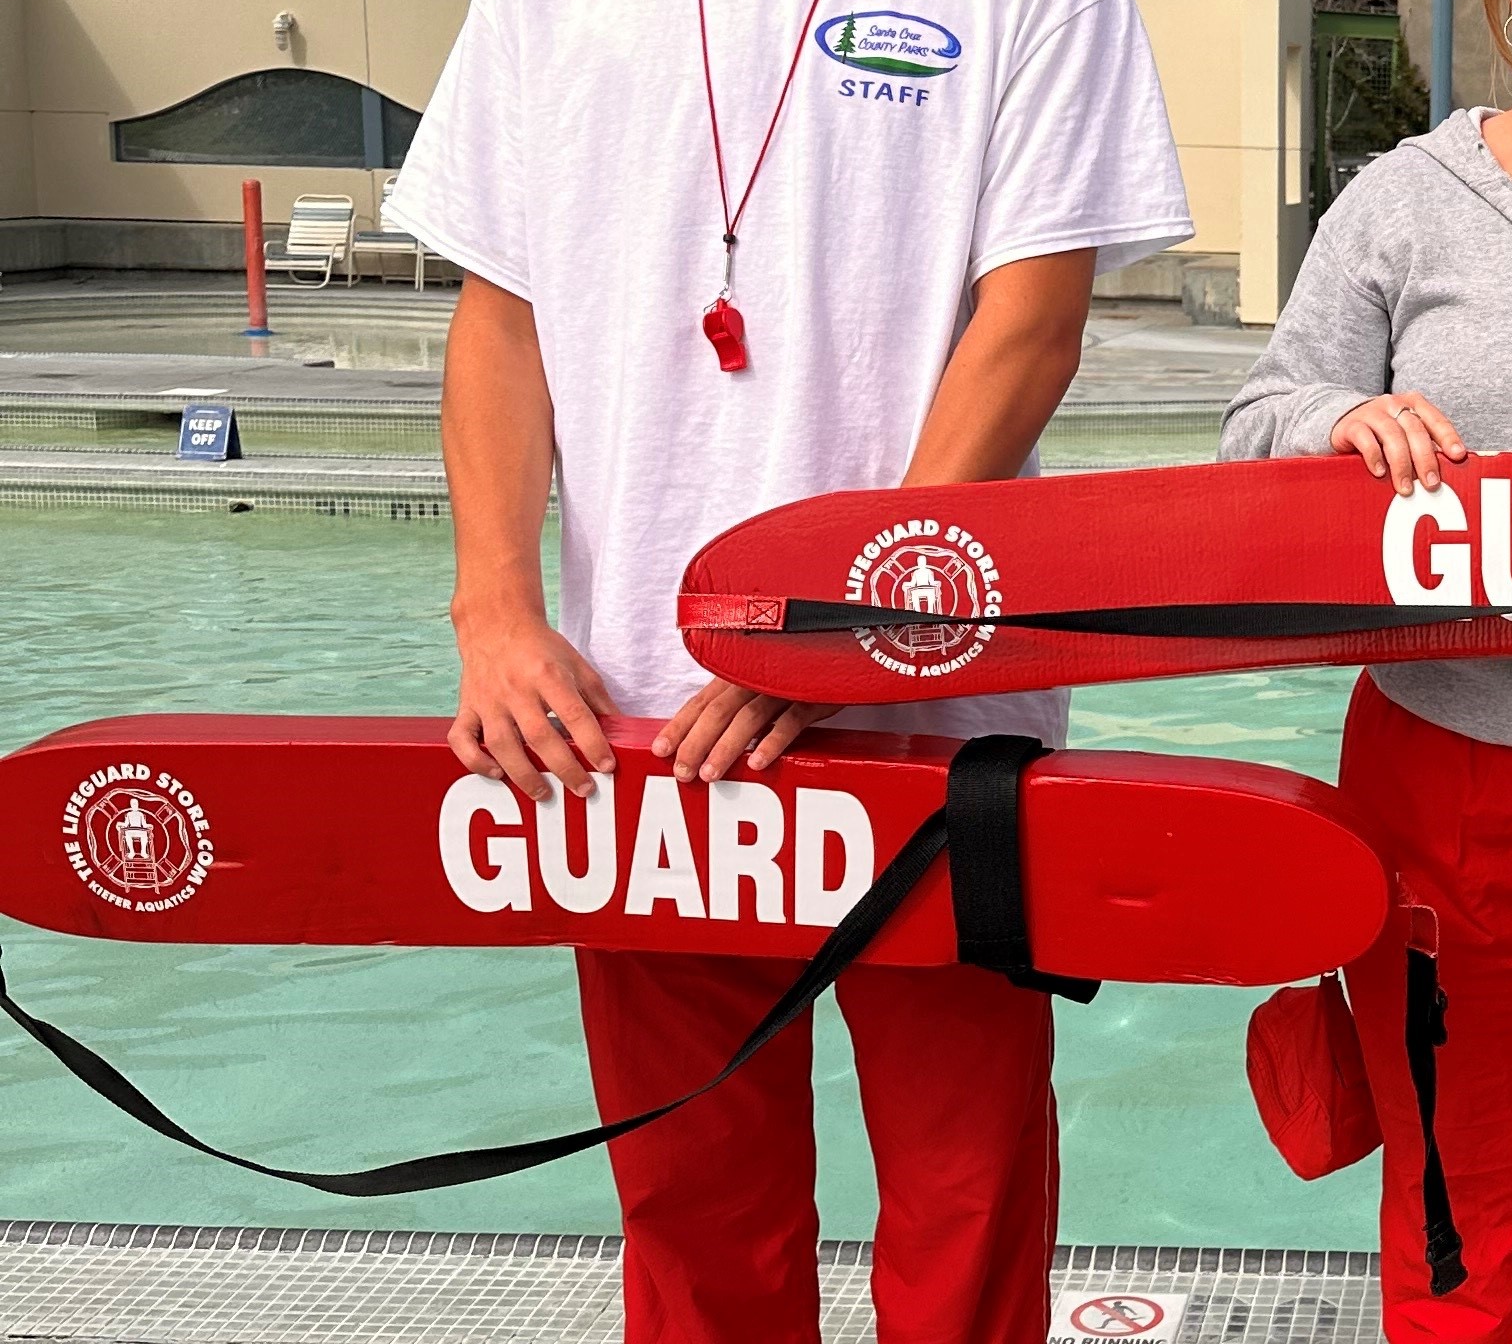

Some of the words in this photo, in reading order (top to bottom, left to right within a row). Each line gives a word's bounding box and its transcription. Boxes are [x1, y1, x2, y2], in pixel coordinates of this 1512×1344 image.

[866, 25, 897, 38] Santa
[899, 27, 922, 41] Cruz
[837, 79, 930, 107] STAFF
[189, 419, 222, 431] KEEP
[191, 433, 217, 446] OFF
[845, 519, 940, 601] LIFEGUARD
[870, 648, 917, 677] KIEFER
[919, 641, 984, 678] AQUATICS
[62, 763, 151, 836] LIFEGUARD
[155, 772, 214, 886] STORE.COM
[64, 841, 94, 882] THE
[438, 771, 875, 928] GUARD
[88, 880, 132, 910] KIEFER
[135, 884, 196, 913] AQUATICS
